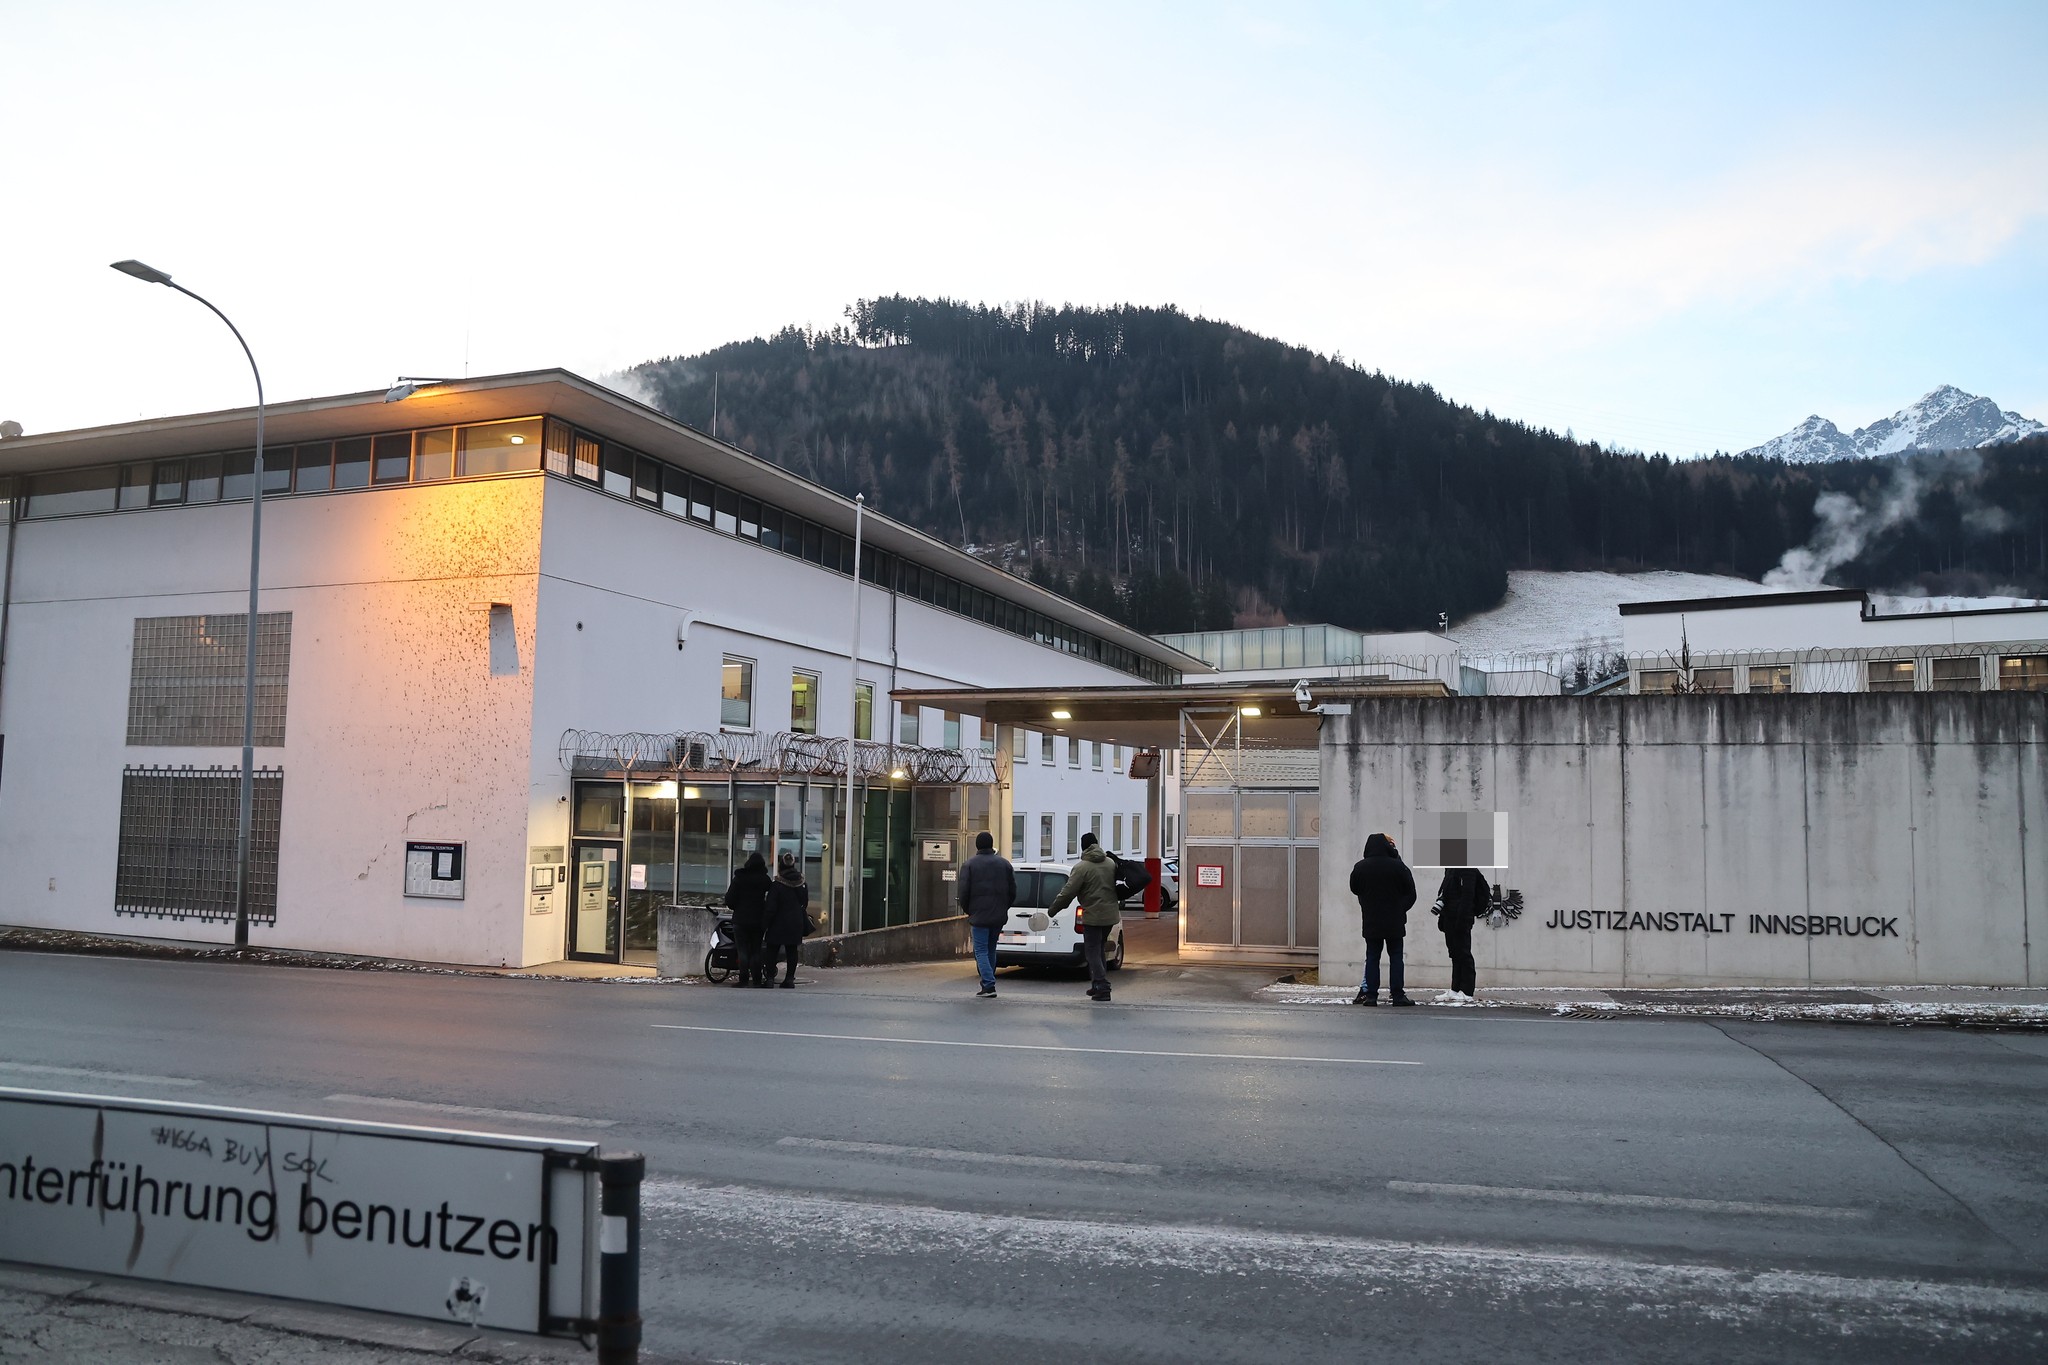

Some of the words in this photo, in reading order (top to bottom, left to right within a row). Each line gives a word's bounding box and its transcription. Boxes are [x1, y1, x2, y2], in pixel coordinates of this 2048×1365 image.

[1546, 910, 1736, 933] JUSTIZANSTALT
[1749, 914, 1899, 937] INNSBRUCK
[222, 1138, 268, 1175] BUY
[282, 1152, 334, 1183] SOL
[0, 1155, 277, 1242] nterführung
[298, 1183, 558, 1265] benutzen
